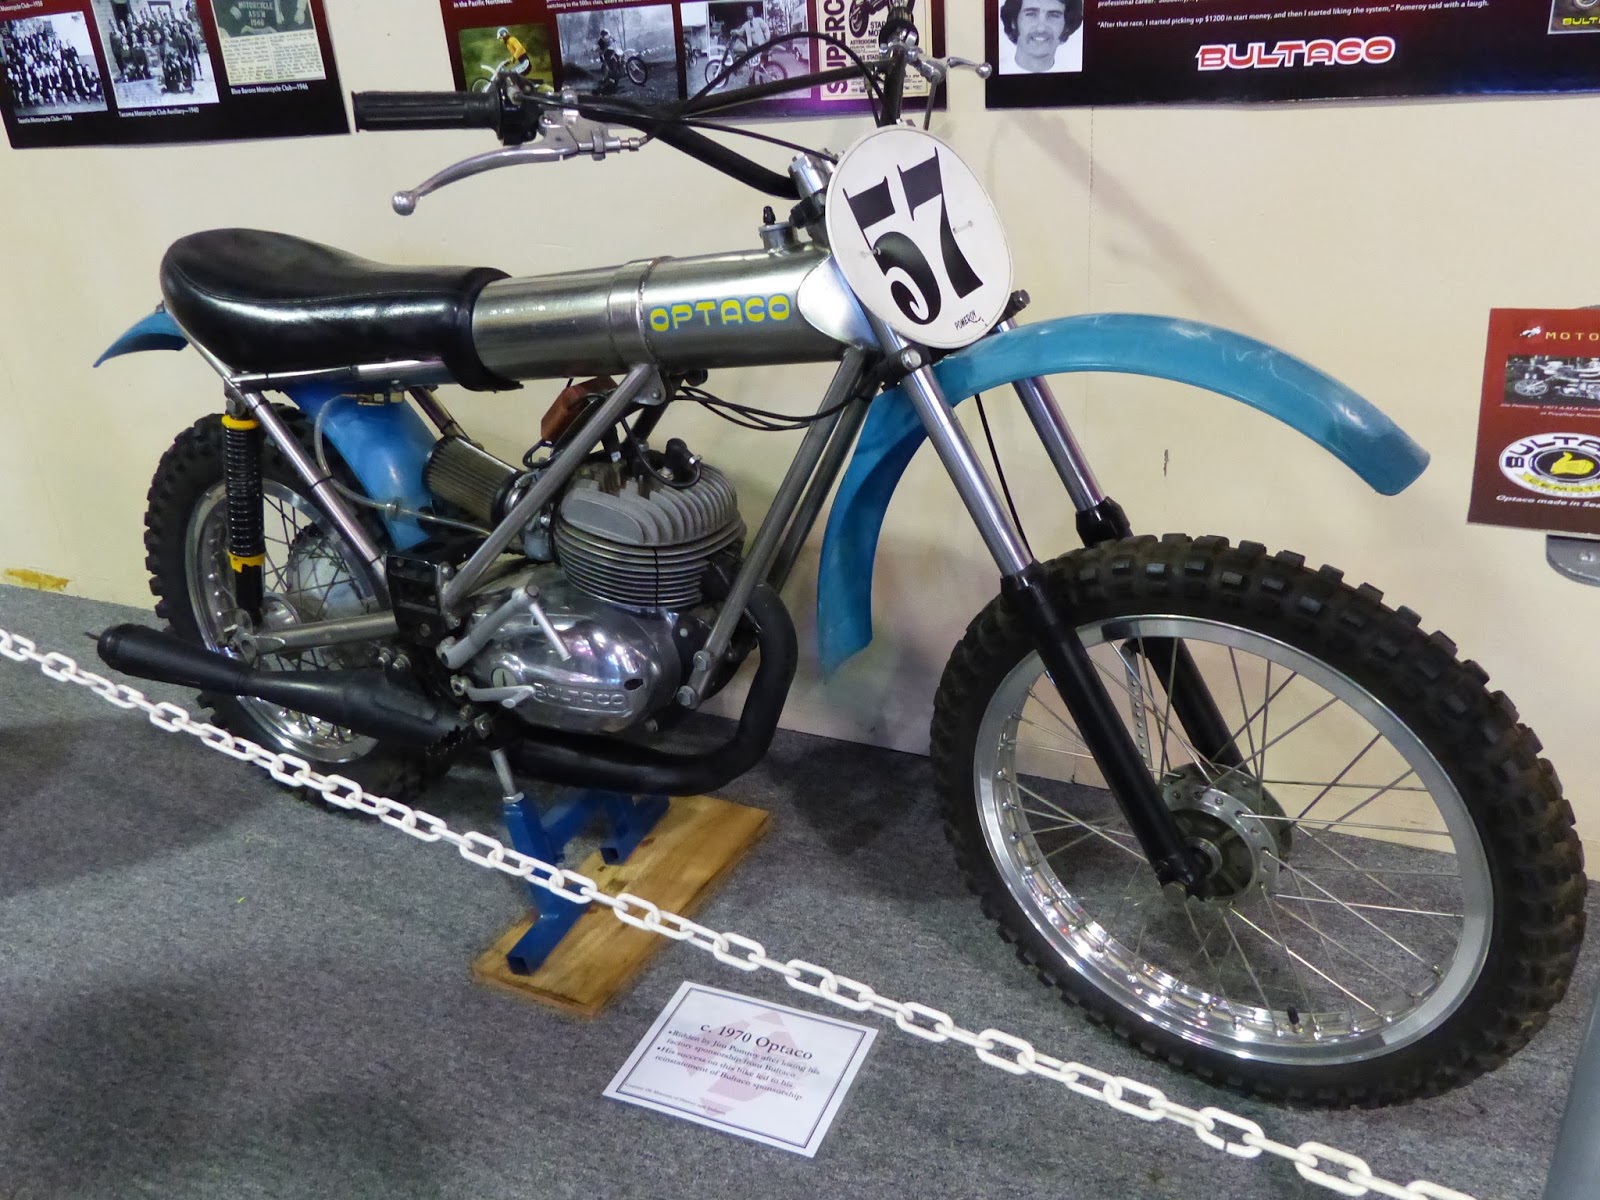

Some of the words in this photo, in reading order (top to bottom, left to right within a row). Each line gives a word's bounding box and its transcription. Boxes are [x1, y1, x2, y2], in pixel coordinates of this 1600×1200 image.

[1171, 17, 1194, 26] picking
[1205, 14, 1225, 23] $1200
[1249, 13, 1272, 21] money,
[1308, 8, 1332, 16] started
[1332, 7, 1352, 16] liking
[1395, 3, 1427, 11] Pomeroy
[1562, 16, 1600, 26] BULT
[1195, 35, 1396, 71] BULTACO
[842, 146, 984, 325] 57
[649, 292, 791, 333] OPTACO
[1496, 494, 1535, 502] Optaco
[667, 1038, 692, 1049] factory
[695, 1046, 742, 1063] sponsorship
[743, 1058, 763, 1069] from
[764, 1064, 796, 1078] Bultaco
[672, 1030, 700, 1042] Ridden
[701, 1037, 710, 1045] by
[761, 1055, 779, 1064] after
[700, 1024, 712, 1033] c.
[719, 1026, 752, 1043] 1970
[755, 1036, 813, 1060] Optaco
[655, 1054, 708, 1073] reinstatement
[720, 1071, 751, 1086] Bultaco
[753, 1082, 803, 1100] sponsorship
[677, 1051, 706, 1063] success
[719, 1062, 735, 1071] this
[736, 1066, 754, 1077] bike
[756, 1072, 770, 1081] led
[780, 1079, 793, 1088] his
